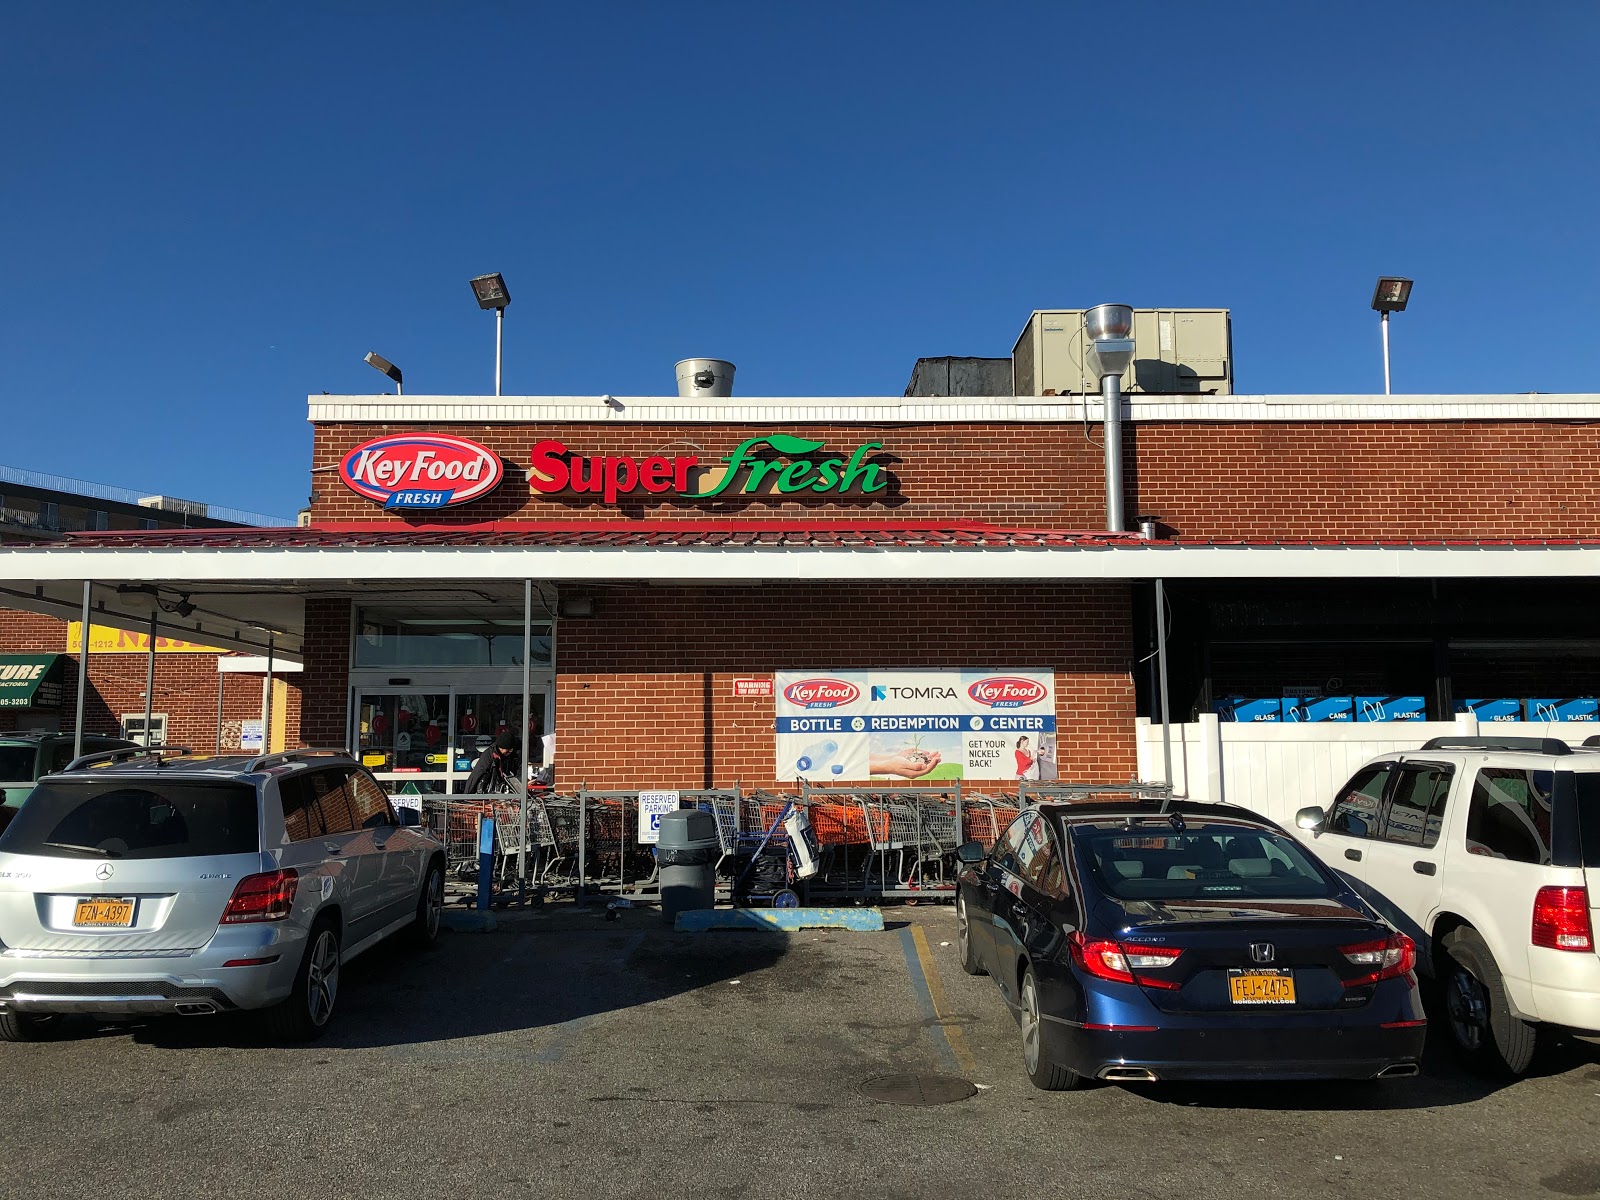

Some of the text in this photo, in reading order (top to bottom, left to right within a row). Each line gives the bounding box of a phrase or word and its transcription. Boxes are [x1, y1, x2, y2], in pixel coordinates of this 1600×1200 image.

[528, 434, 888, 504] Super fresh
[395, 493, 442, 504] FRESH
[737, 681, 771, 689] WARNING
[889, 687, 958, 699] TOMRA
[790, 717, 1044, 731] BOTTLE REDEMPTION CENTER
[968, 740, 1006, 748] GET YOUR
[969, 749, 1000, 758] NICKELS
[969, 759, 992, 768] BACK!
[641, 795, 676, 804] RESERVED
[644, 804, 674, 813] PARKING
